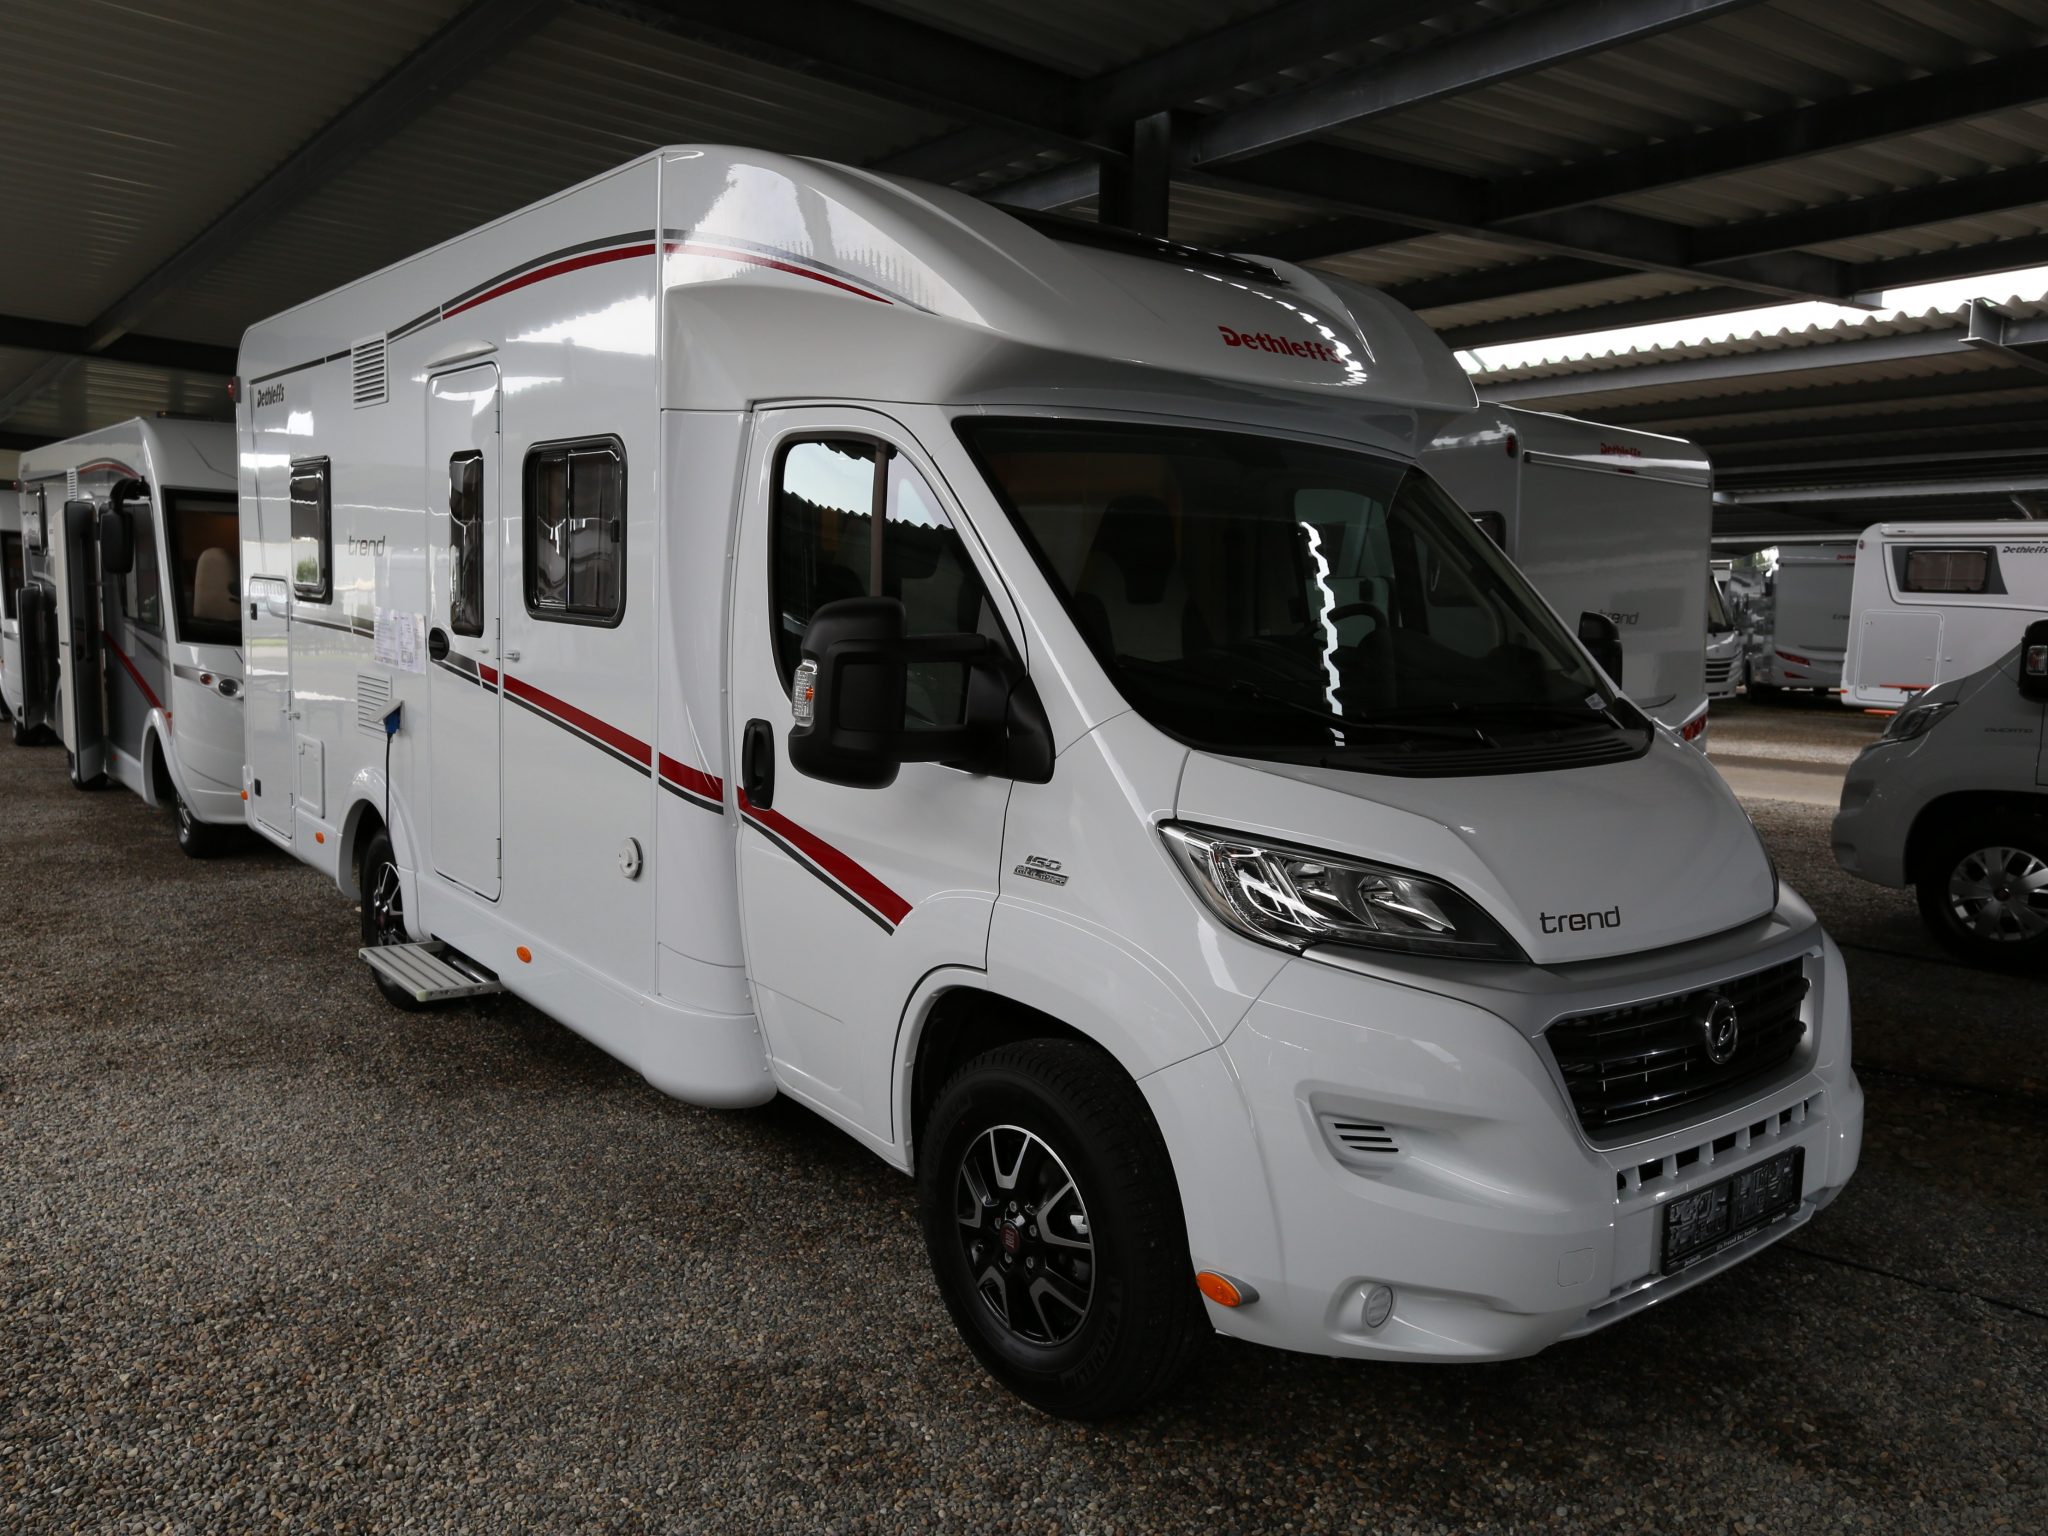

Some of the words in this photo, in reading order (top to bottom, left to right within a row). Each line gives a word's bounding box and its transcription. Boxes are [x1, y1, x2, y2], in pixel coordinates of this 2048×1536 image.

[1217, 325, 1342, 364] Dethleffs
[348, 535, 386, 557] trend
[1025, 854, 1062, 871] 150
[1539, 905, 1621, 934] trend
